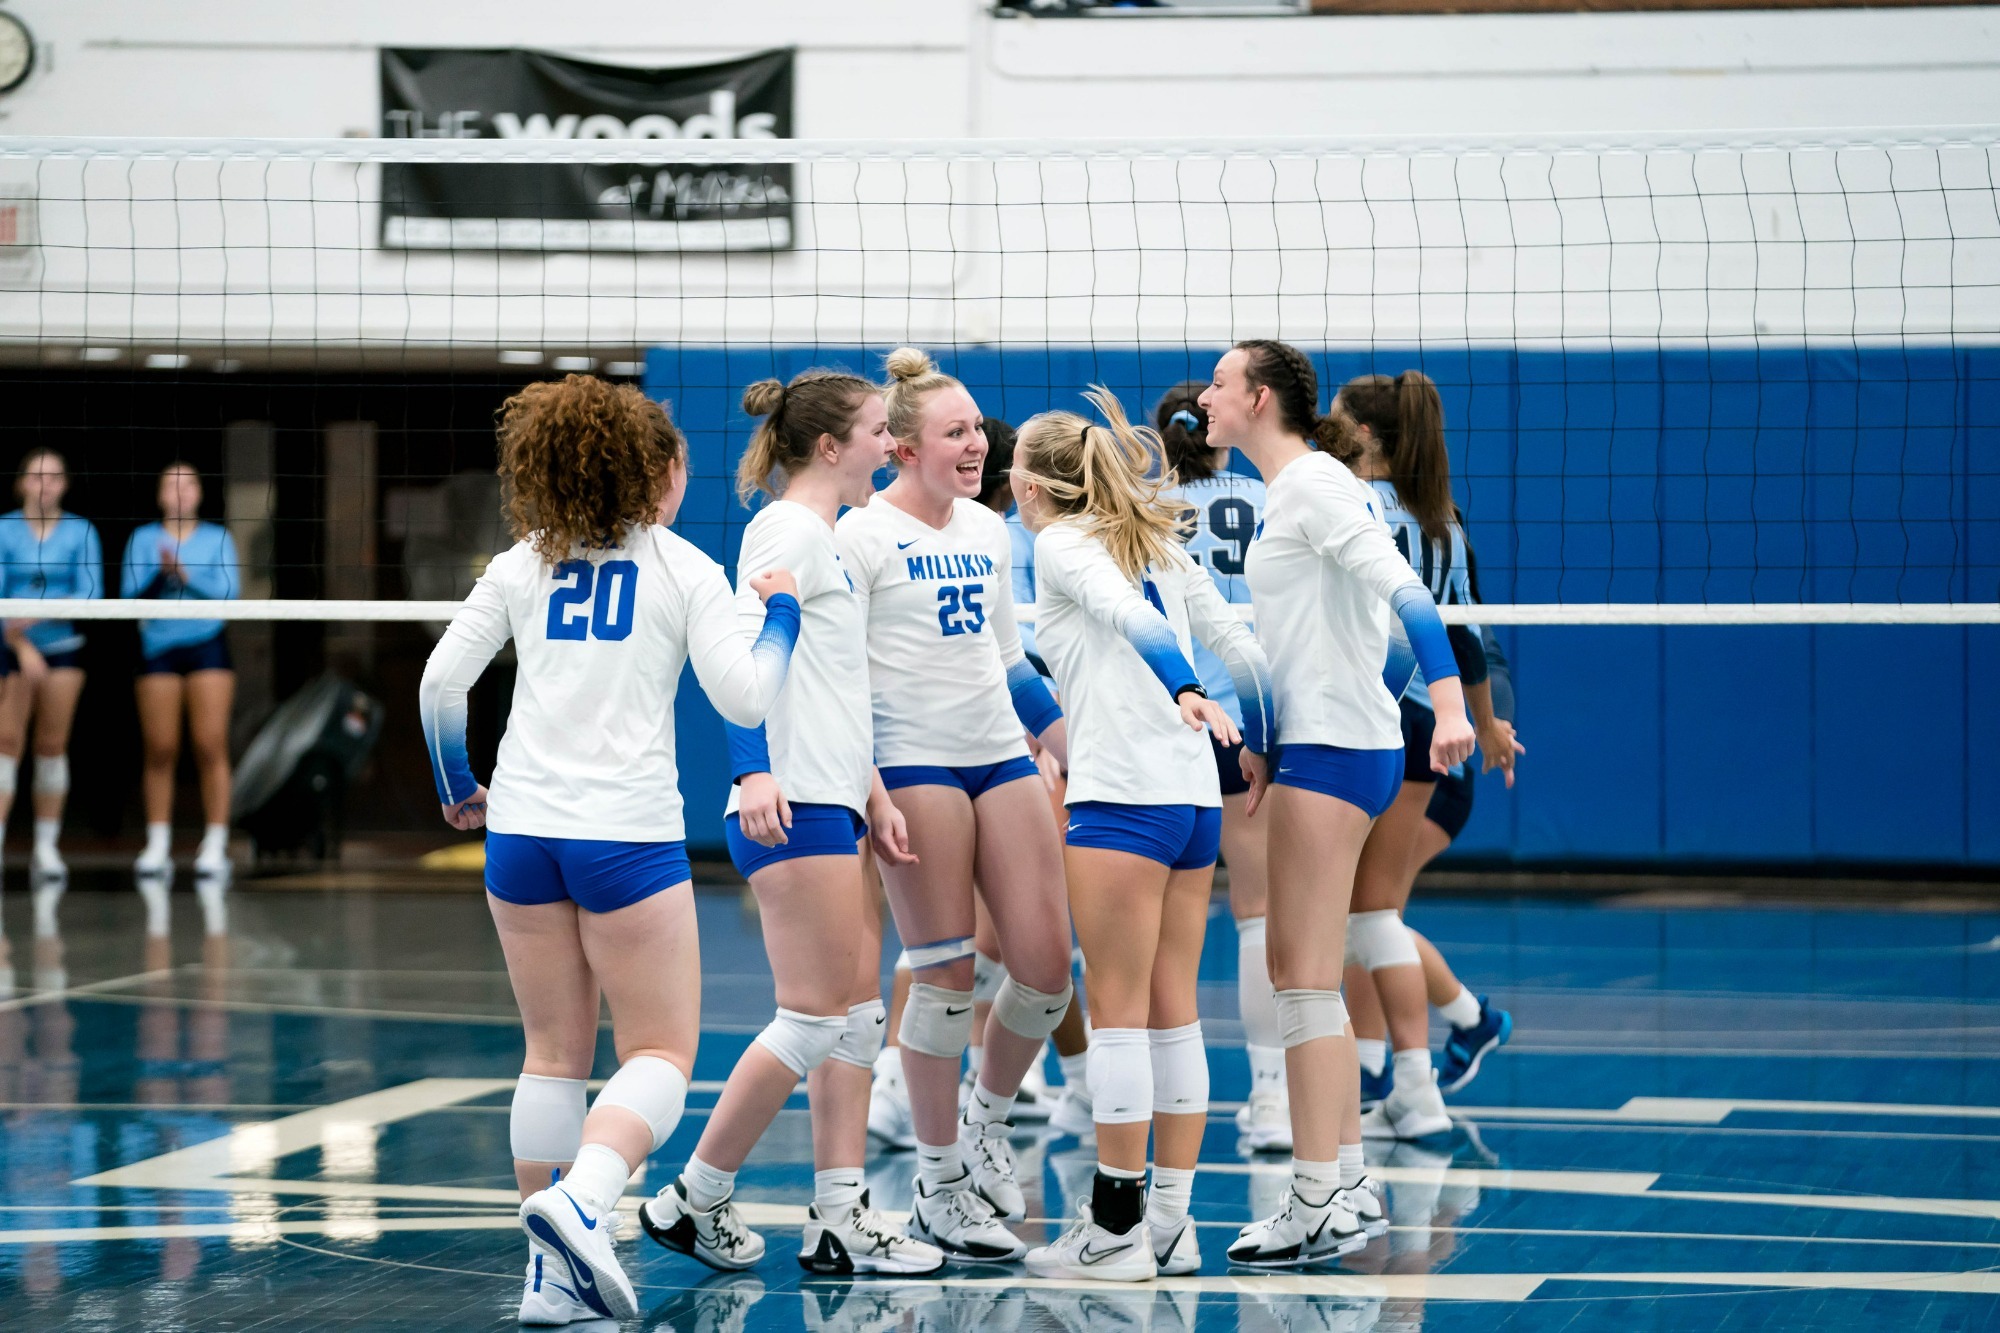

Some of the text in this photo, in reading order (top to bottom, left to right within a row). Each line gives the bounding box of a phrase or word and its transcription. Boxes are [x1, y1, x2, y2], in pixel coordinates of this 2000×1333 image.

[493, 90, 779, 166] woods
[546, 558, 639, 641] 20
[937, 584, 986, 637] 25
